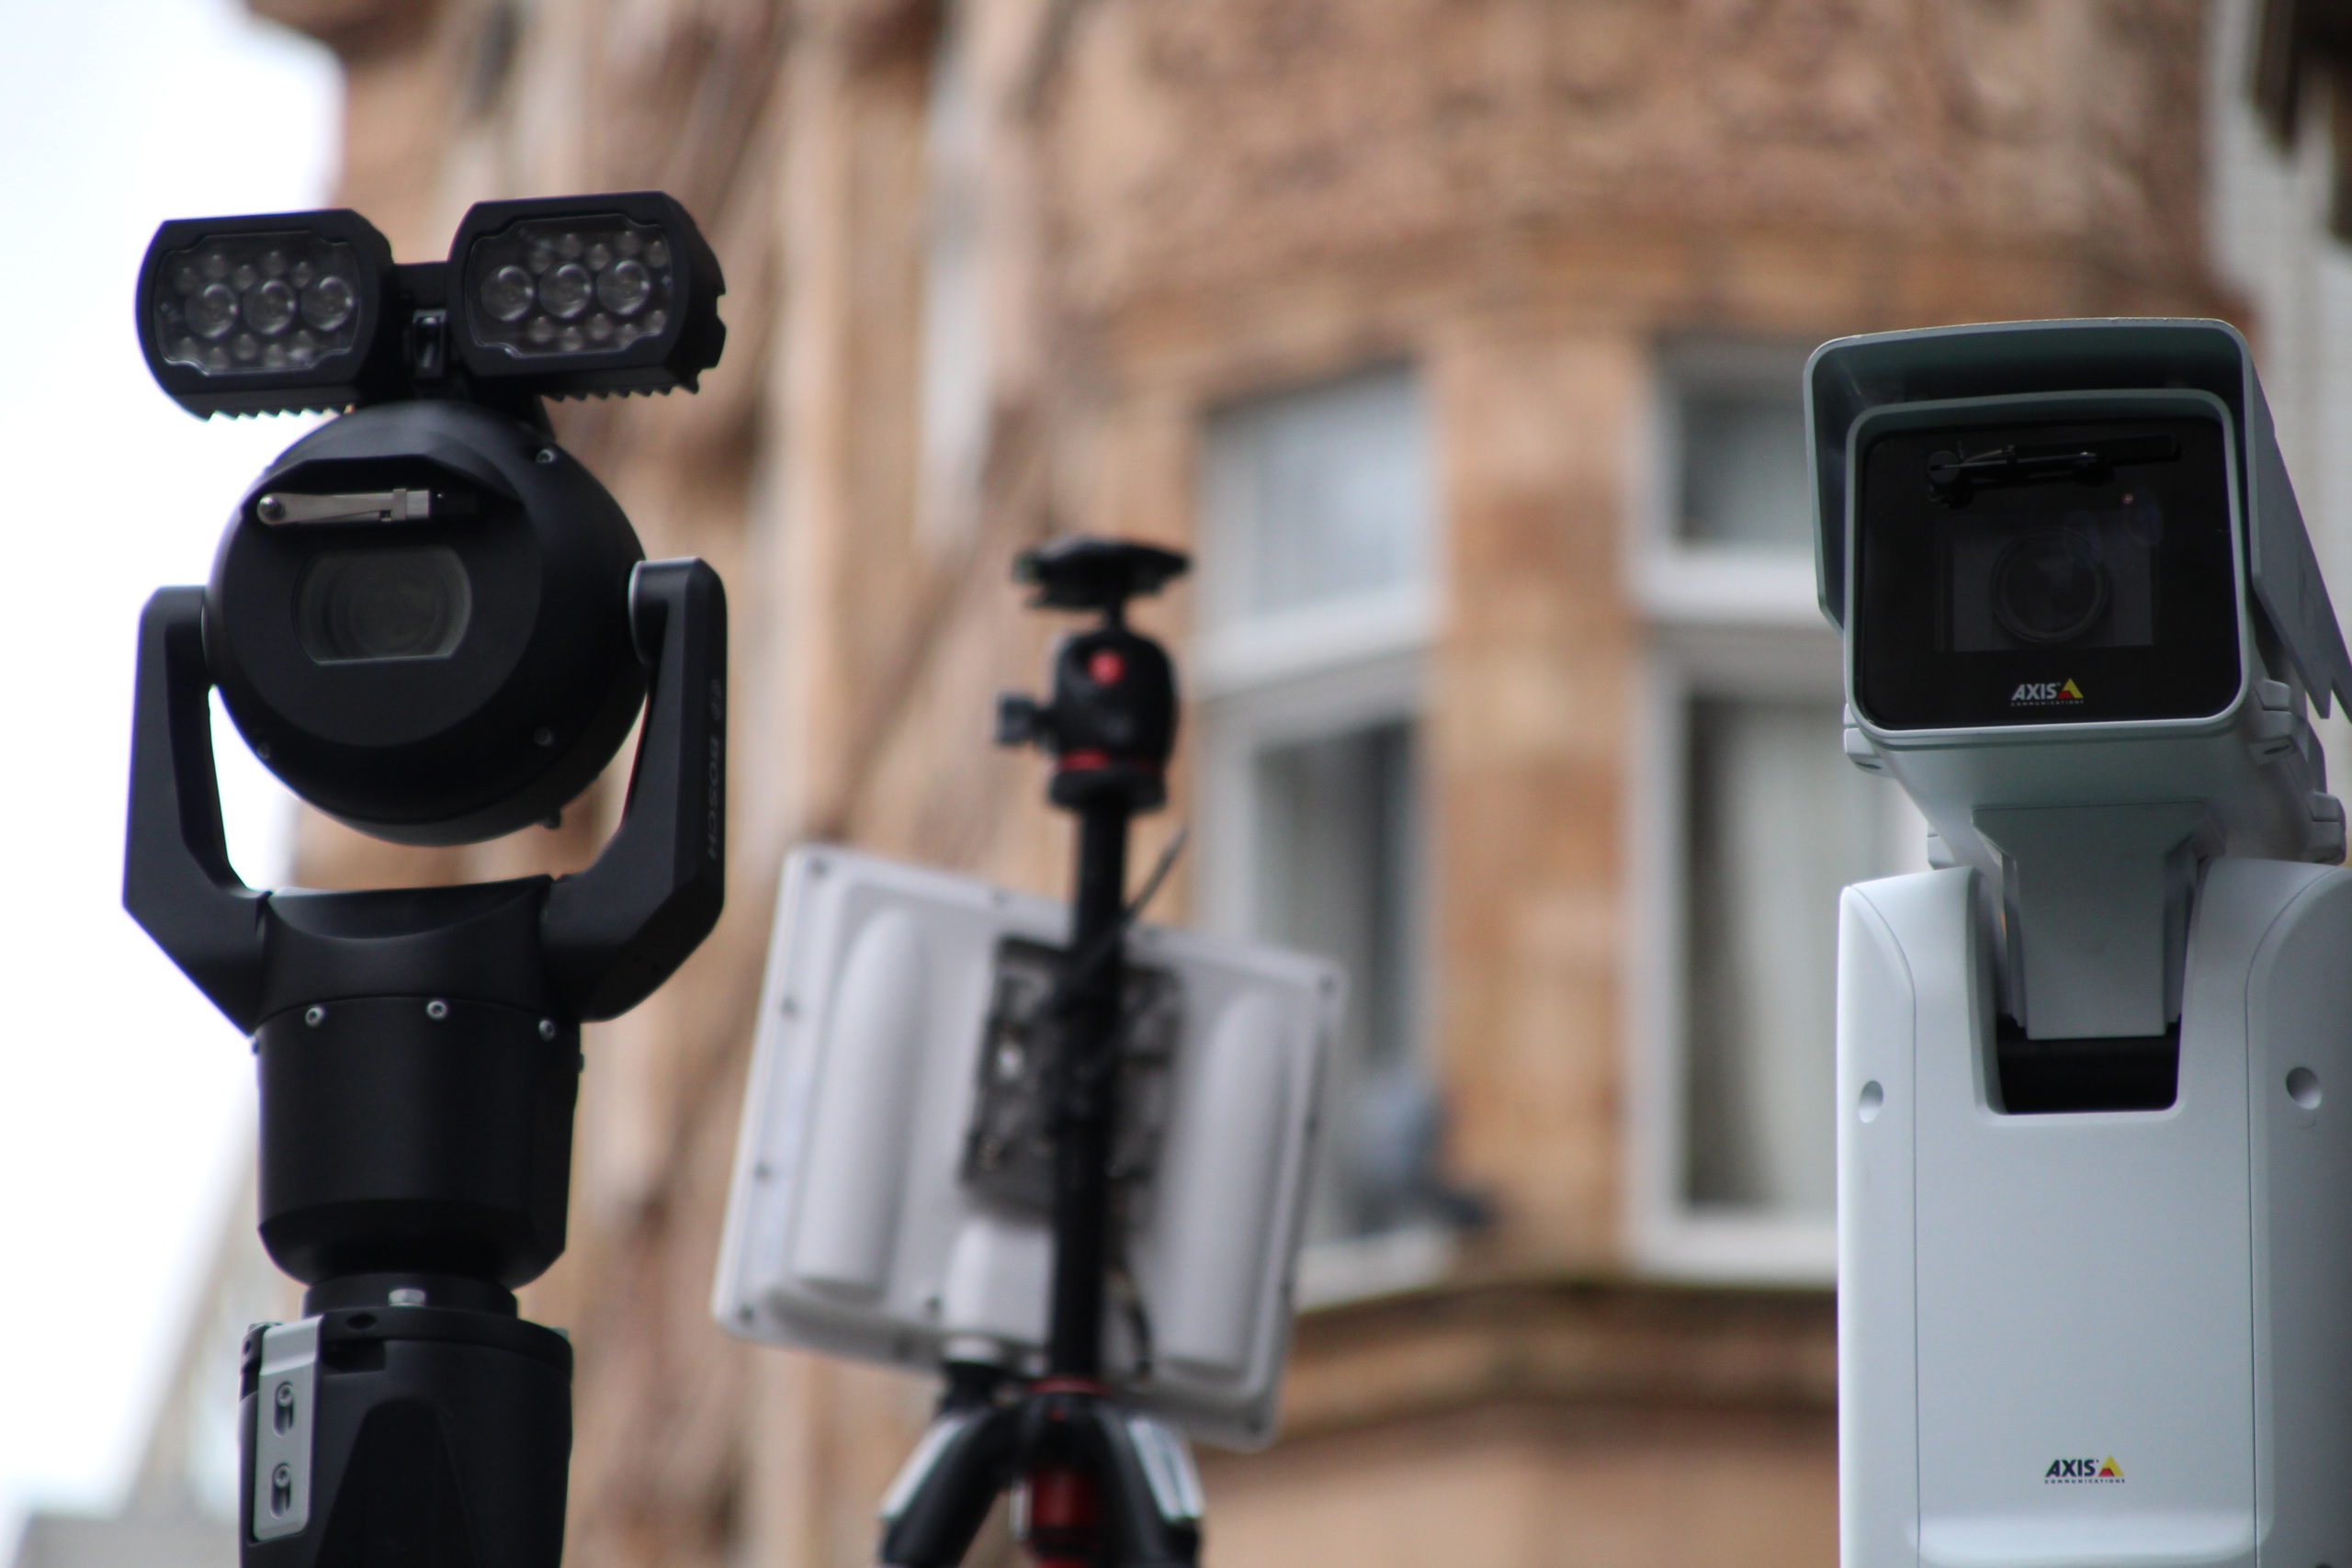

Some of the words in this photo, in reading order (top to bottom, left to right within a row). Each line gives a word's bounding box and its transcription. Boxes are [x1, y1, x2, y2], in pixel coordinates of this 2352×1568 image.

[2011, 682, 2058, 700] AXIS
[707, 736, 720, 862] BOSCH
[2045, 1459, 2097, 1477] AXIS
